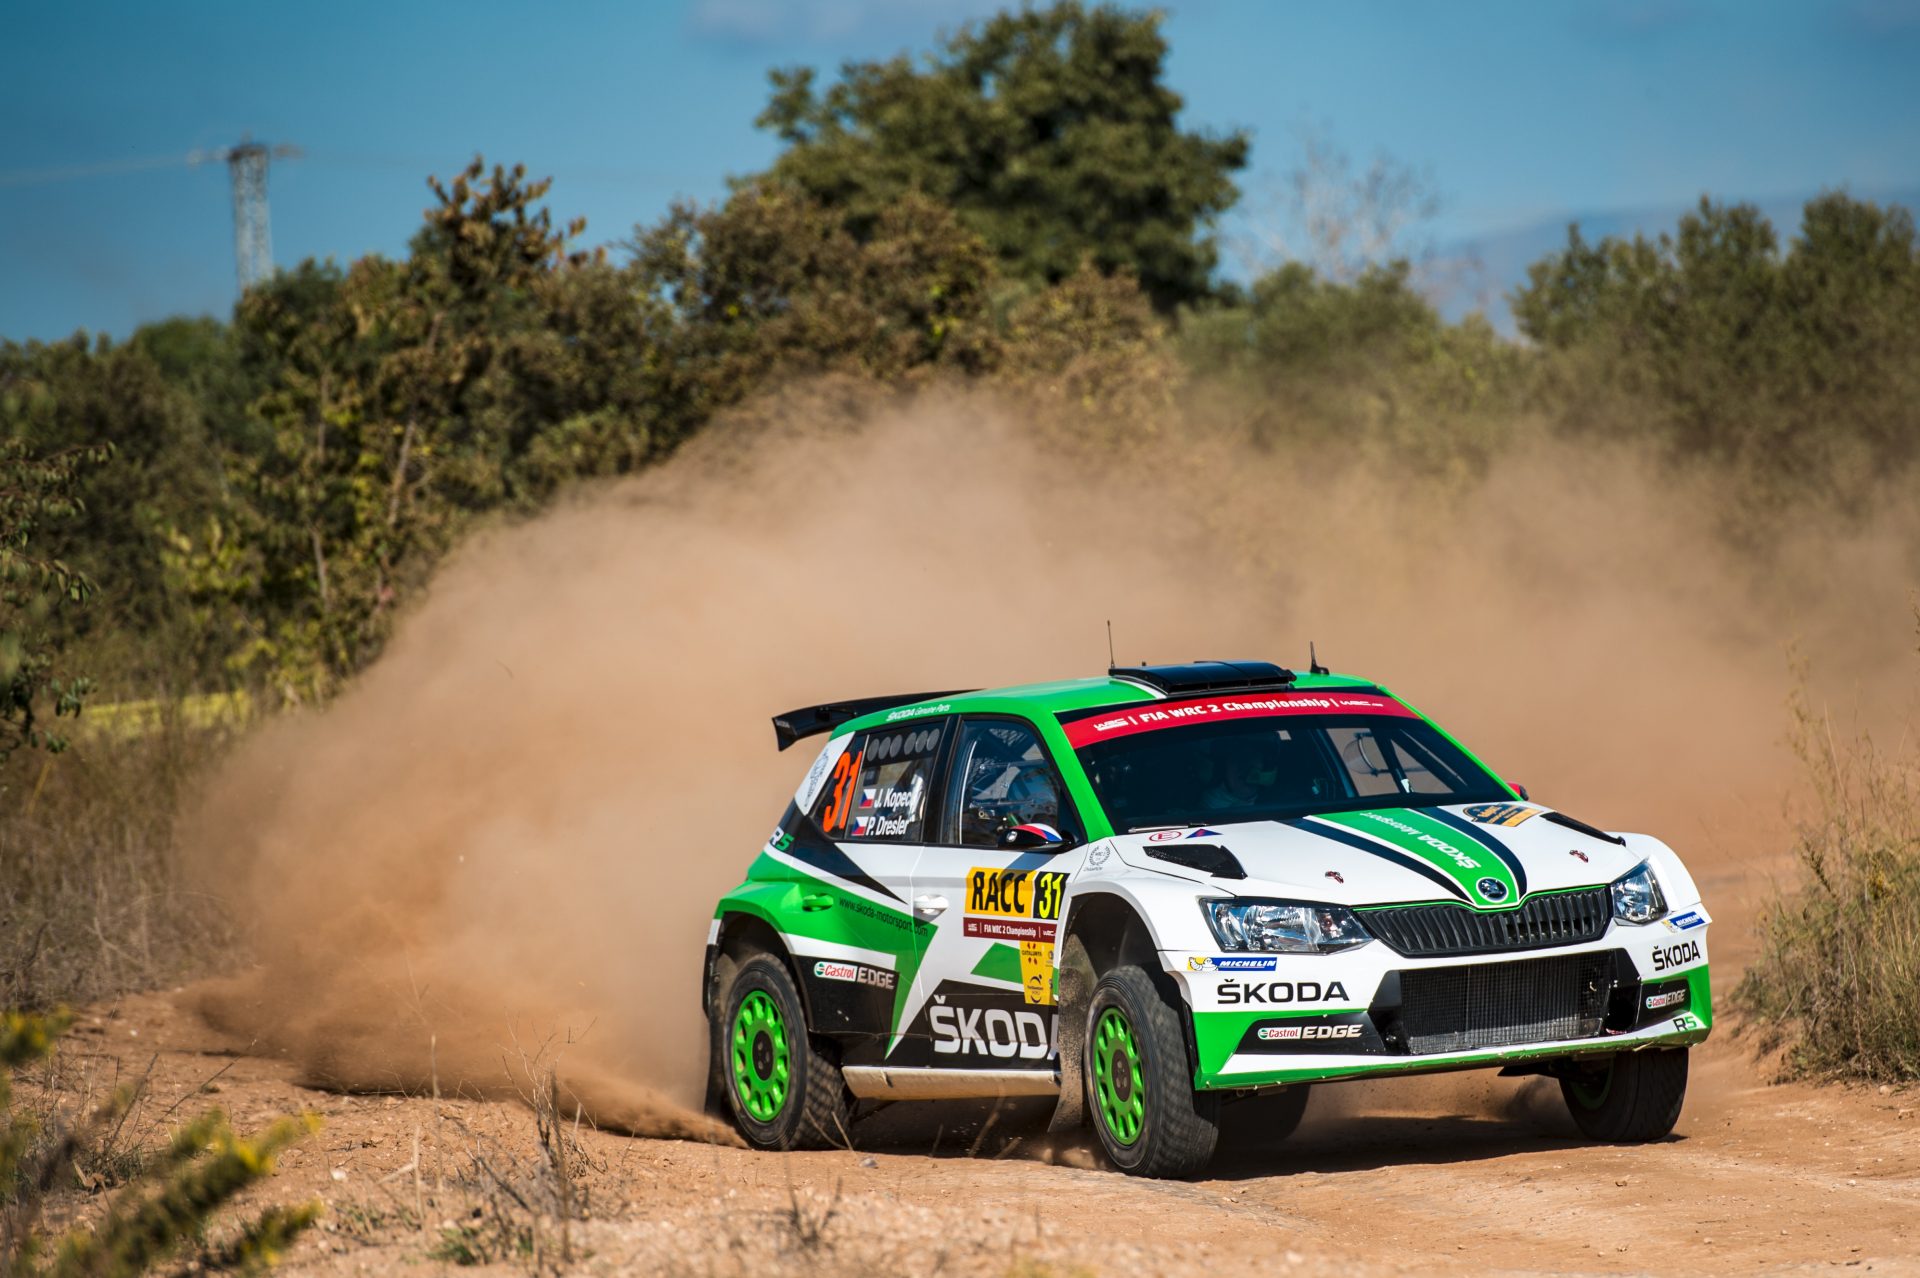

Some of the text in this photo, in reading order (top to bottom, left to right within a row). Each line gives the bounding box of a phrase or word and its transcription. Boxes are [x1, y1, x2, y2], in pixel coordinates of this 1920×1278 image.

[1139, 711, 1169, 723] FIA
[1168, 706, 1207, 718] WRC
[1207, 704, 1221, 713] 2
[1223, 699, 1331, 713] Championship
[823, 751, 863, 833] 31
[874, 788, 884, 808] J.
[866, 815, 910, 836] P. Dresler
[769, 826, 795, 851] R5
[1418, 834, 1482, 869] ŠKODA
[972, 871, 1064, 919] RACC 31
[1219, 959, 1276, 968] MICHELIN
[1652, 940, 1701, 971] ŠKODA
[825, 965, 895, 990] Castrol EDGE
[1217, 978, 1350, 1005] ŠKODA
[1667, 989, 1686, 1005] EDGE
[1268, 1024, 1363, 1040] Castrol EDGE
[1673, 1016, 1697, 1032] R5
